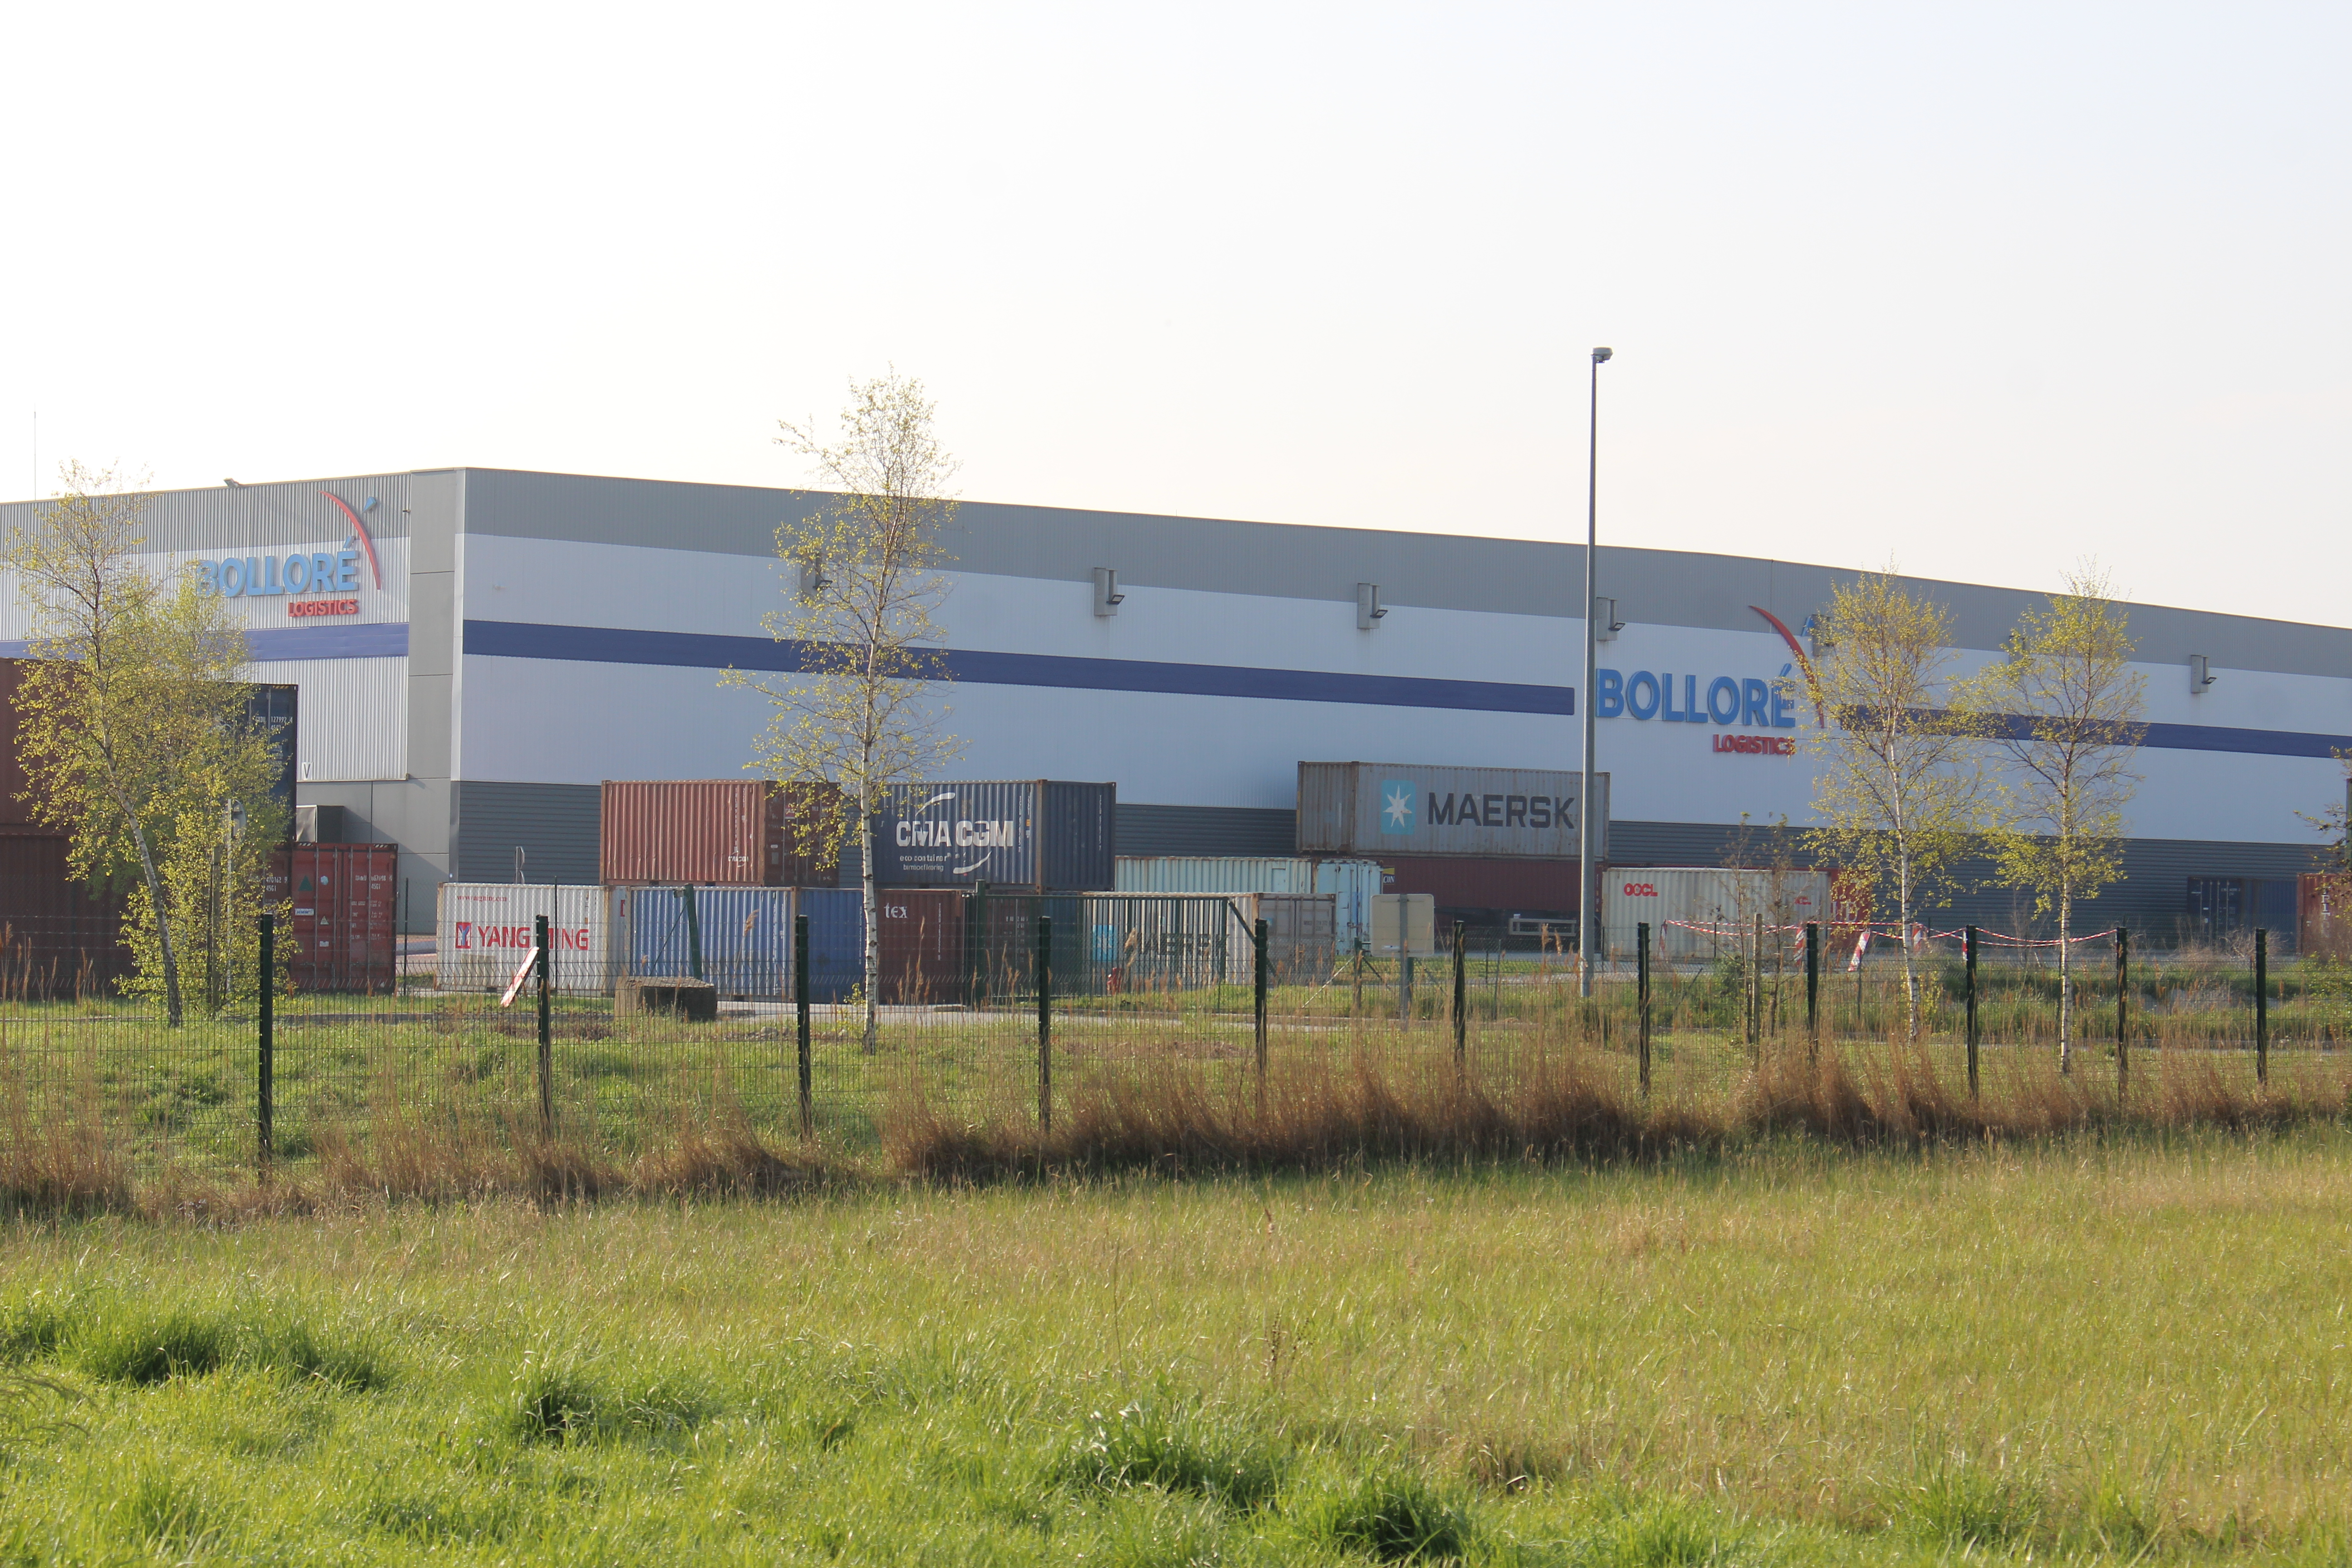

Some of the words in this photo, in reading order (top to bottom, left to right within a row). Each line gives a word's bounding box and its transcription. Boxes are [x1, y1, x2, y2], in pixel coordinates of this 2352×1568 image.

[196, 535, 359, 598] BOLLORÉ
[288, 599, 359, 617] LOGISTICS
[1595, 663, 1796, 727] BOLLORÉ
[1713, 734, 1796, 755] LOGISTICS
[1428, 792, 1575, 829] MAERSK
[896, 821, 952, 847] CMA
[956, 821, 1014, 847] CGM
[1624, 883, 1658, 897] OOCL
[884, 903, 907, 918] tex
[477, 926, 530, 948] YANG
